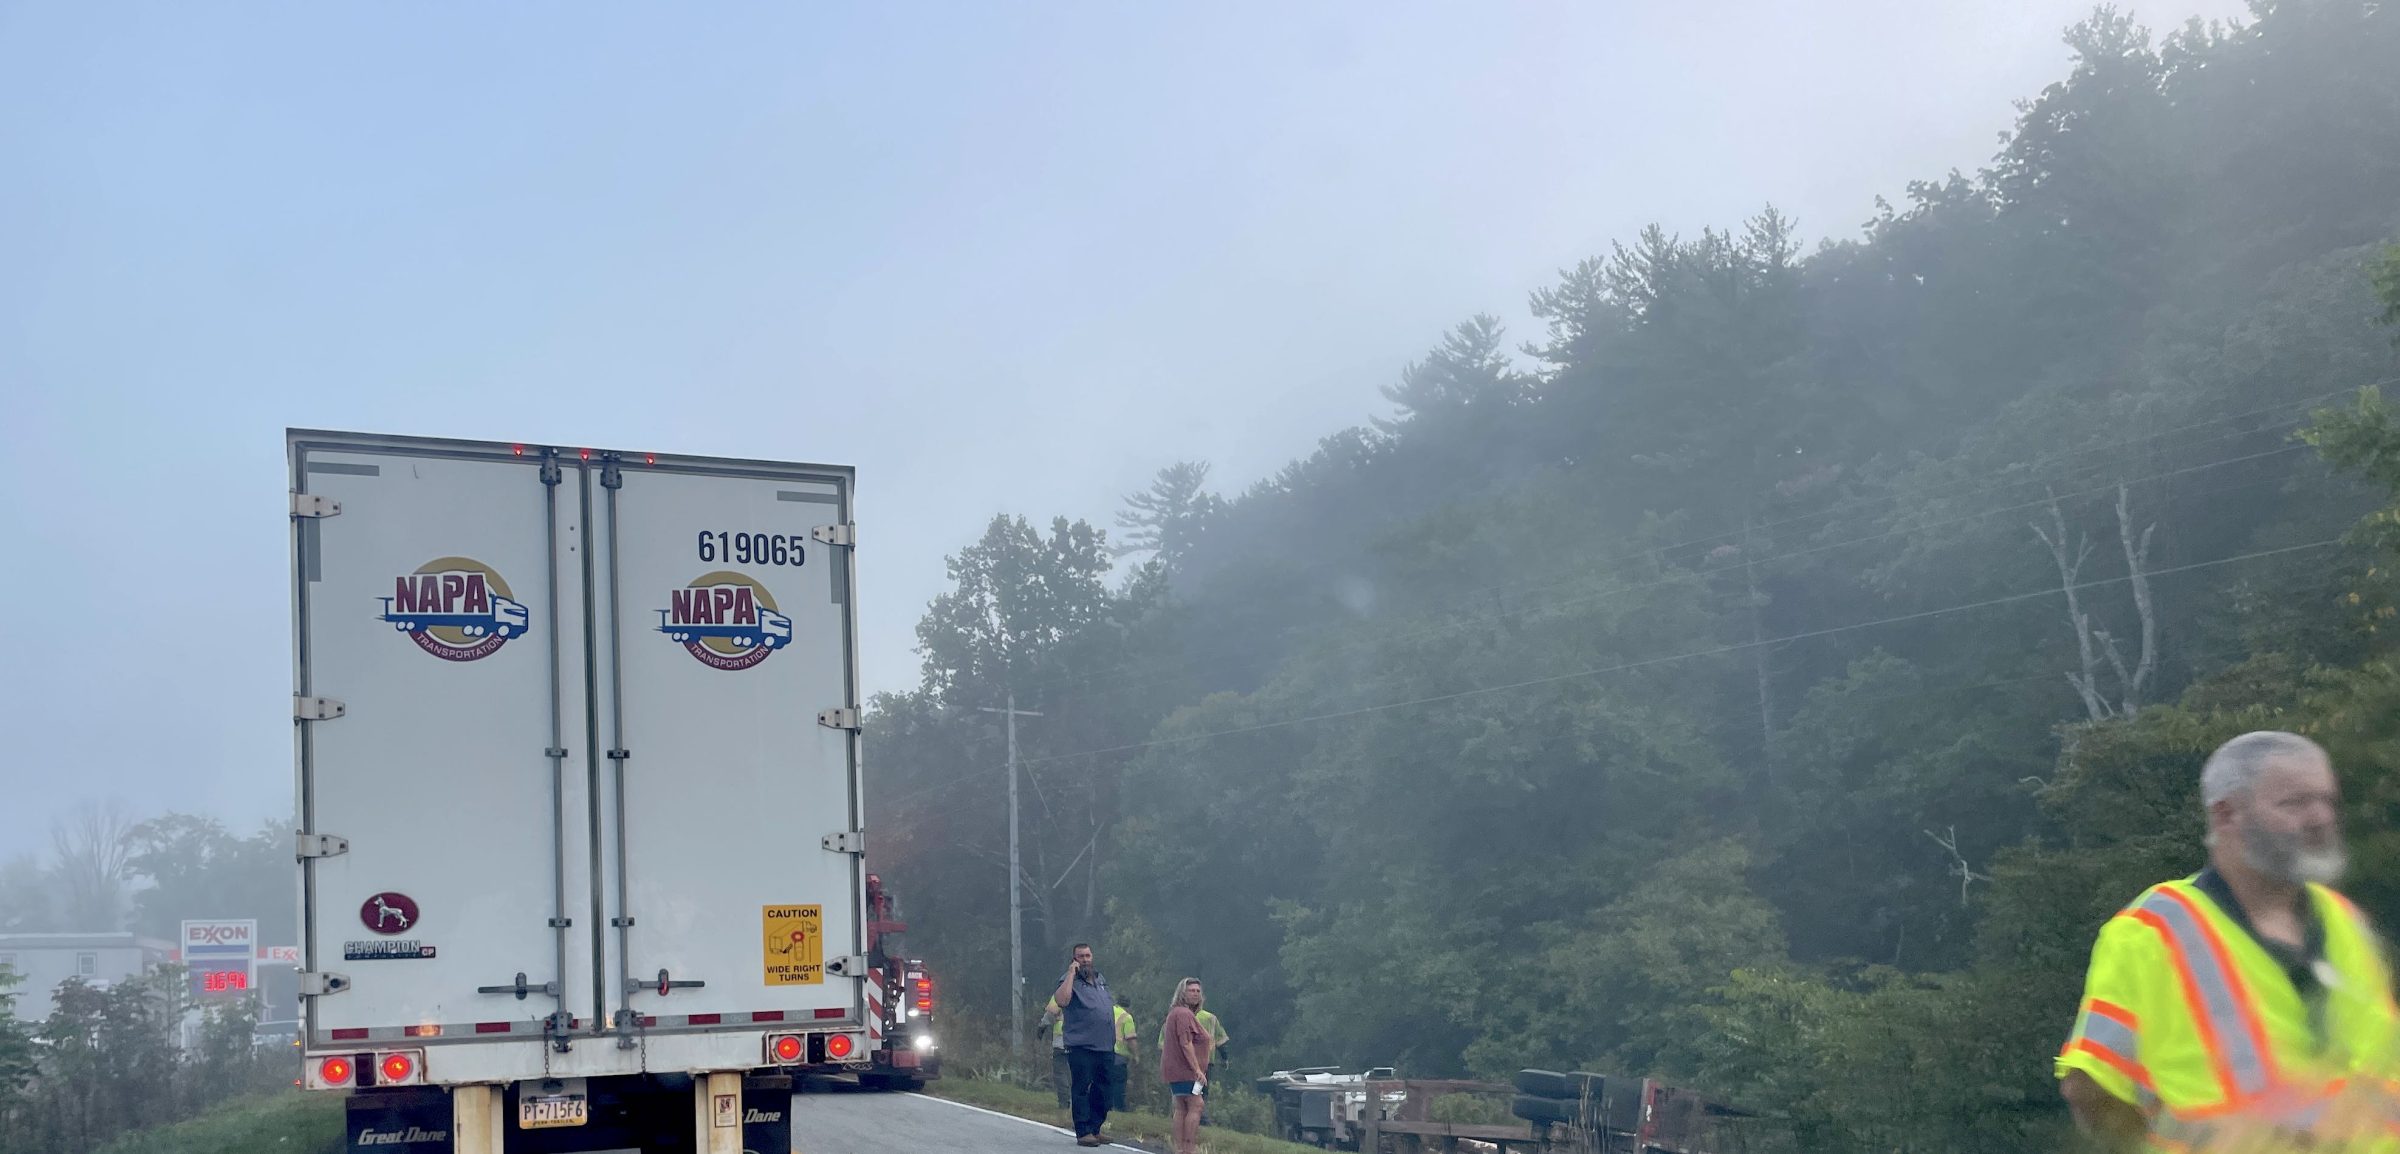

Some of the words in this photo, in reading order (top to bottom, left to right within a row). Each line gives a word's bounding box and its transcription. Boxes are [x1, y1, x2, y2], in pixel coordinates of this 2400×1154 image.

[698, 530, 805, 567] 619065
[396, 574, 489, 613] NAPA
[671, 587, 756, 625] NAPA
[417, 633, 503, 659] TRANSPORTATION
[691, 644, 769, 668] TRANSPORTATION
[767, 909, 817, 918] CAUTION
[189, 925, 249, 944] EXXON
[272, 948, 297, 960] EXX
[344, 939, 420, 954] CHAMPION
[767, 965, 791, 974] WIDE
[793, 964, 821, 973] RIGHT
[779, 973, 810, 982] TURNS
[743, 1108, 781, 1124] Dane
[358, 1128, 404, 1146] Great
[403, 1126, 447, 1143] Dane
